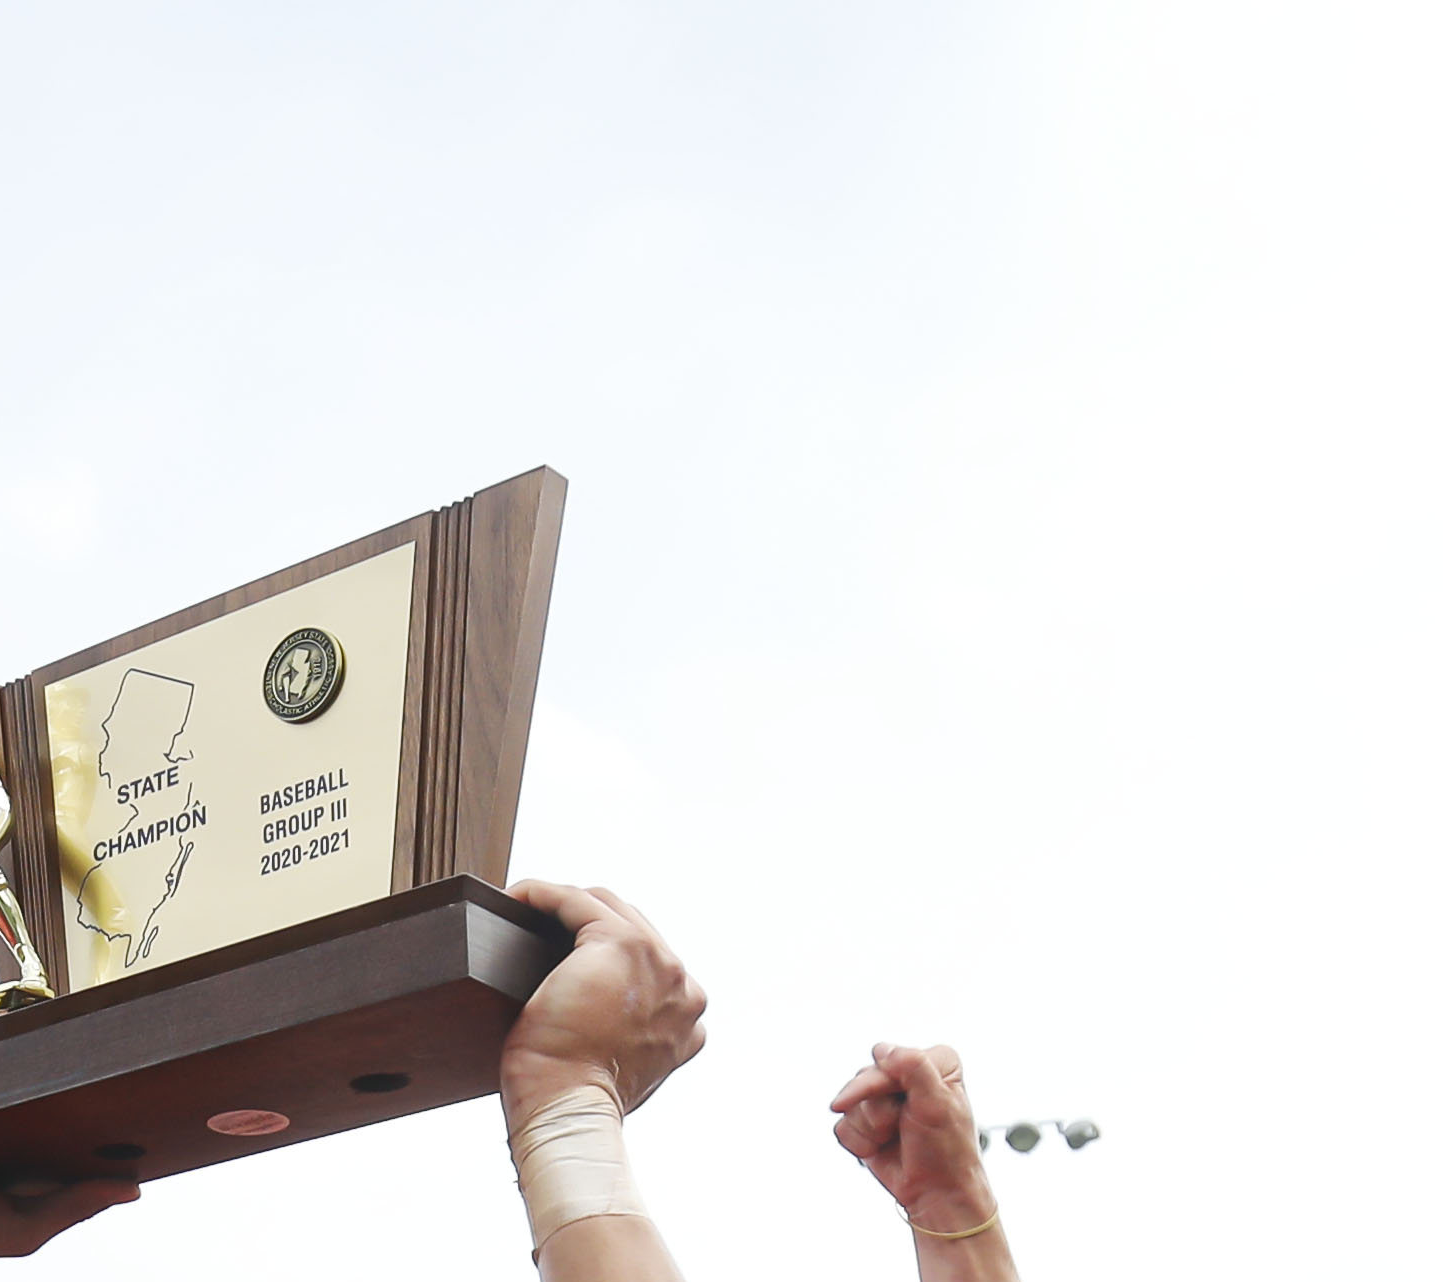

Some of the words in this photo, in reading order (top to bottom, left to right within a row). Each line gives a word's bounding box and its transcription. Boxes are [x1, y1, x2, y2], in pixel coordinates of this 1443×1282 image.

[117, 766, 179, 804] STATE
[260, 768, 349, 815] BASEBALL
[93, 805, 207, 862] CHAMPION
[263, 806, 325, 844] GROUP
[330, 798, 347, 822] III
[260, 829, 349, 876] 2020-2021
